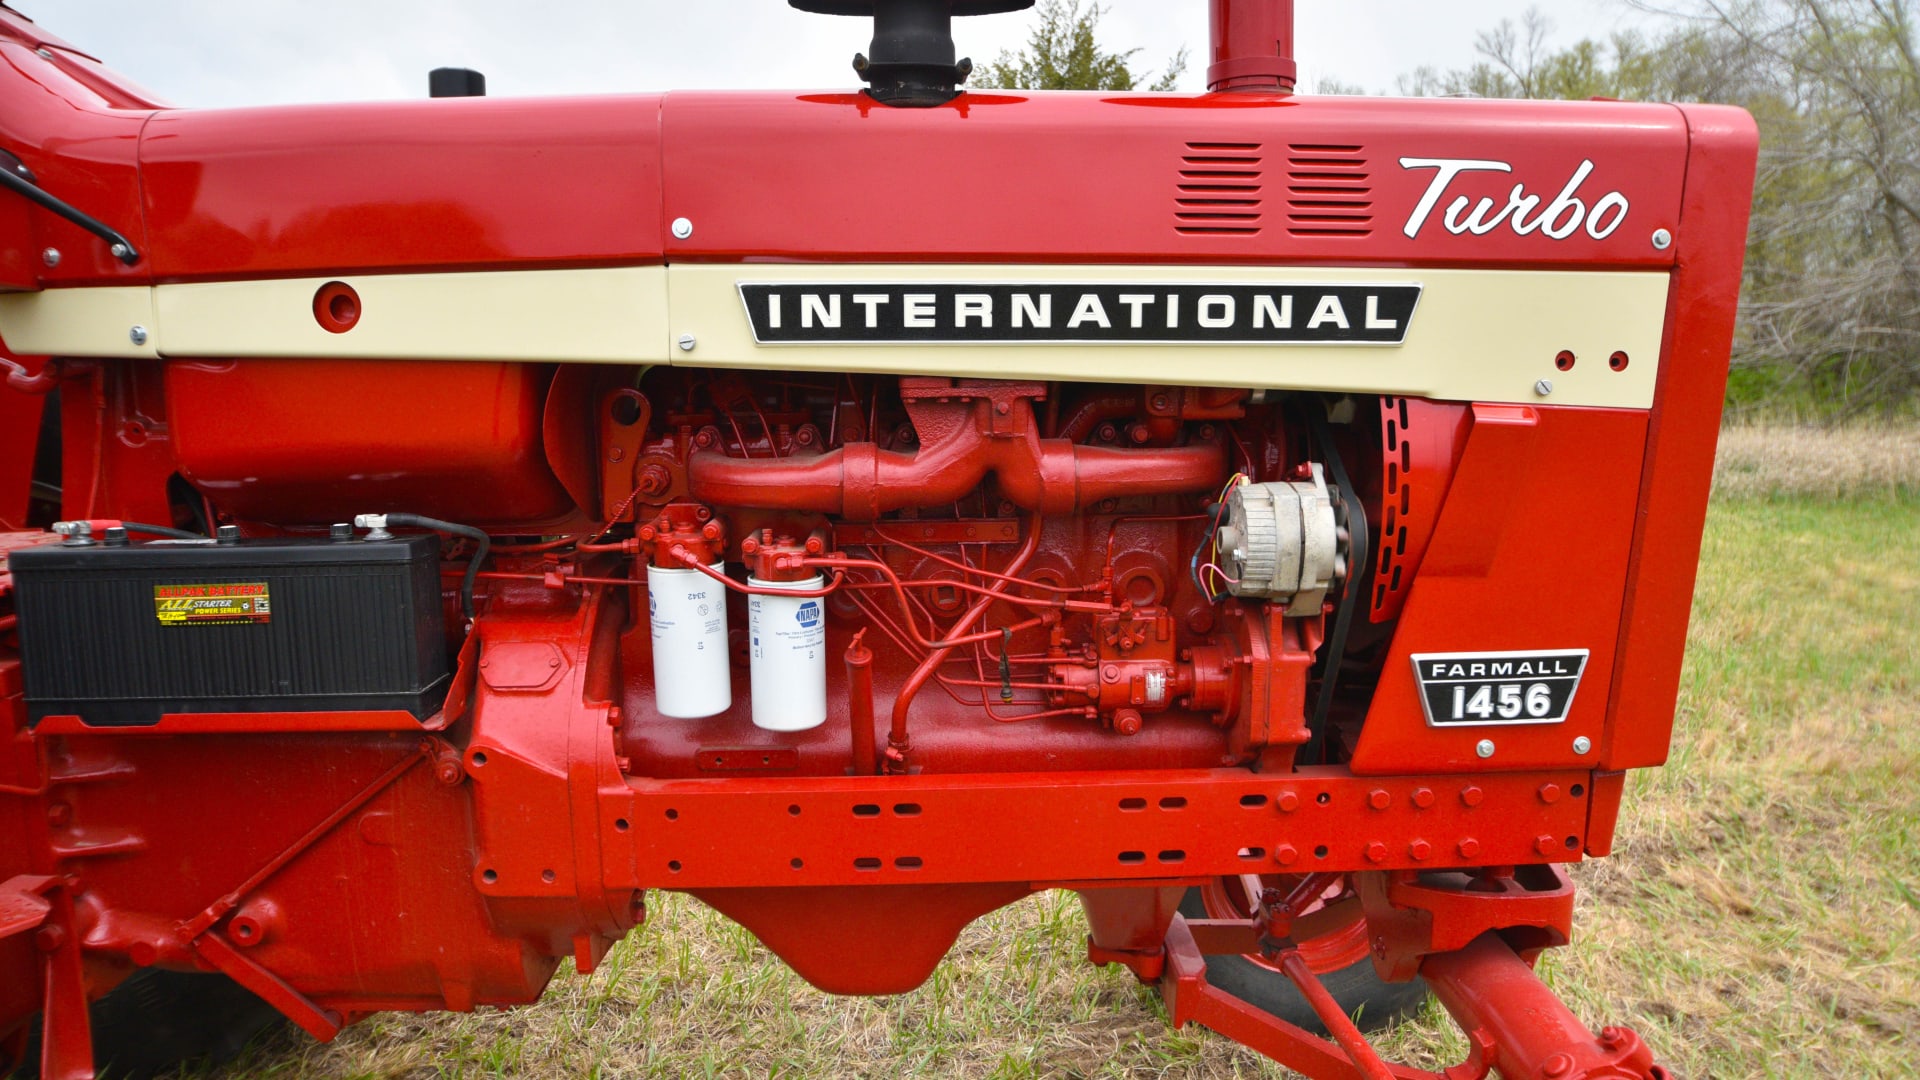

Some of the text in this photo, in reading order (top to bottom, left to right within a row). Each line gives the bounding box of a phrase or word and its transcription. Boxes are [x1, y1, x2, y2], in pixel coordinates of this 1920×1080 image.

[1398, 157, 1629, 240] Turbo
[767, 293, 1398, 330] INTERNATIONAL
[208, 585, 264, 596] BATTERY
[159, 599, 232, 610] ALL STARTER
[800, 607, 818, 622] NAPA
[1431, 660, 1568, 677] FARMALL
[1452, 683, 1552, 720] 1456
